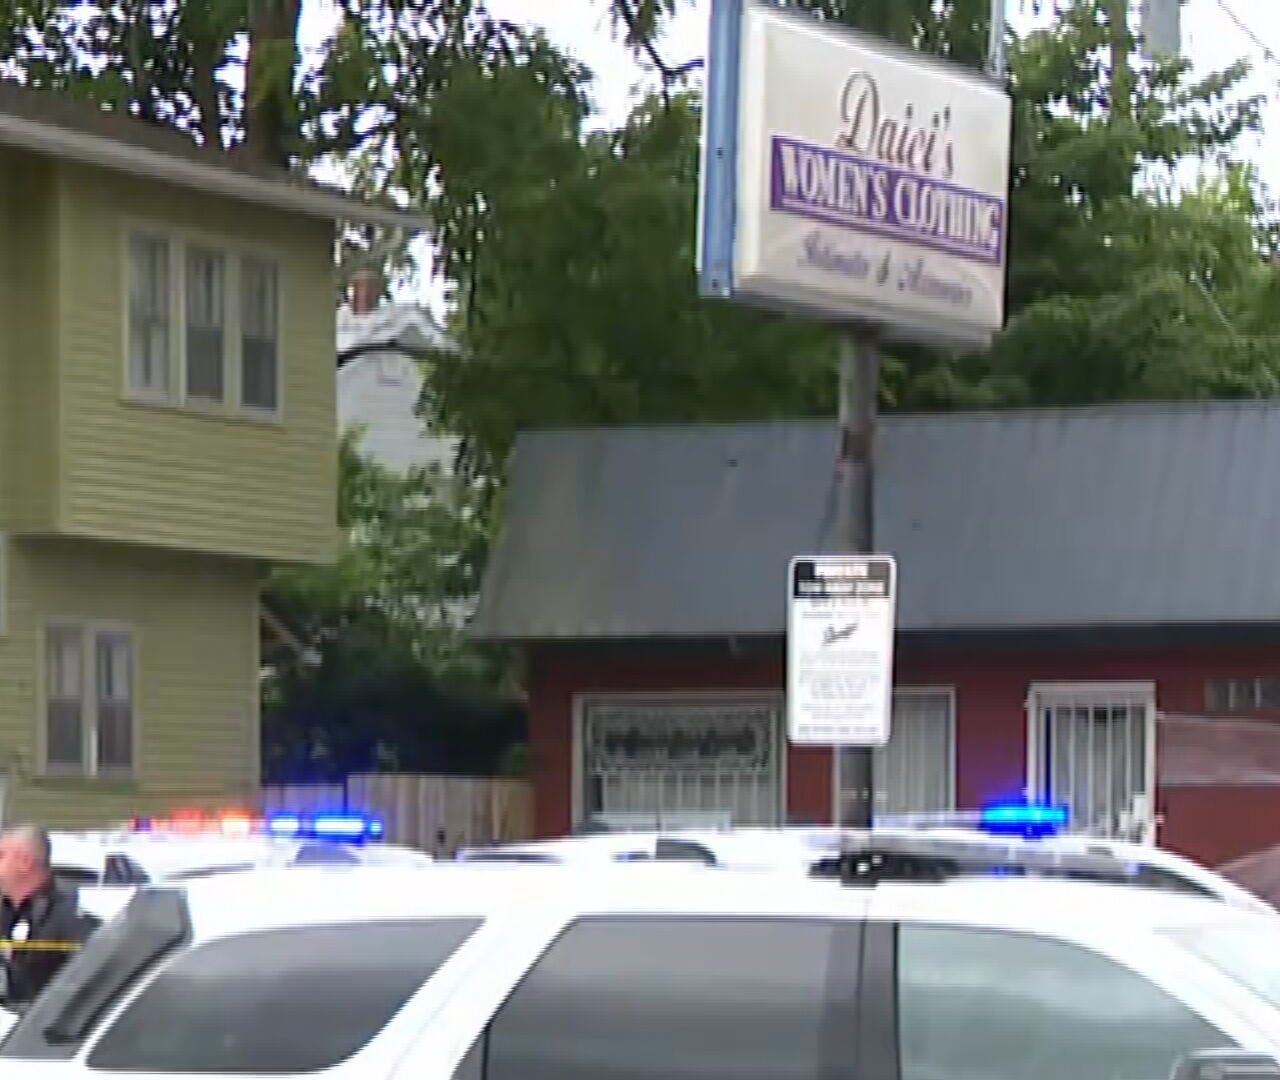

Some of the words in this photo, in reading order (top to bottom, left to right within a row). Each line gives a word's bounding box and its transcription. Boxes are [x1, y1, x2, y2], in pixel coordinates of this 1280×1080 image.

[836, 70, 954, 180] Daici's
[780, 142, 889, 220] WOMEN'S
[894, 175, 1001, 249] CLOTHING
